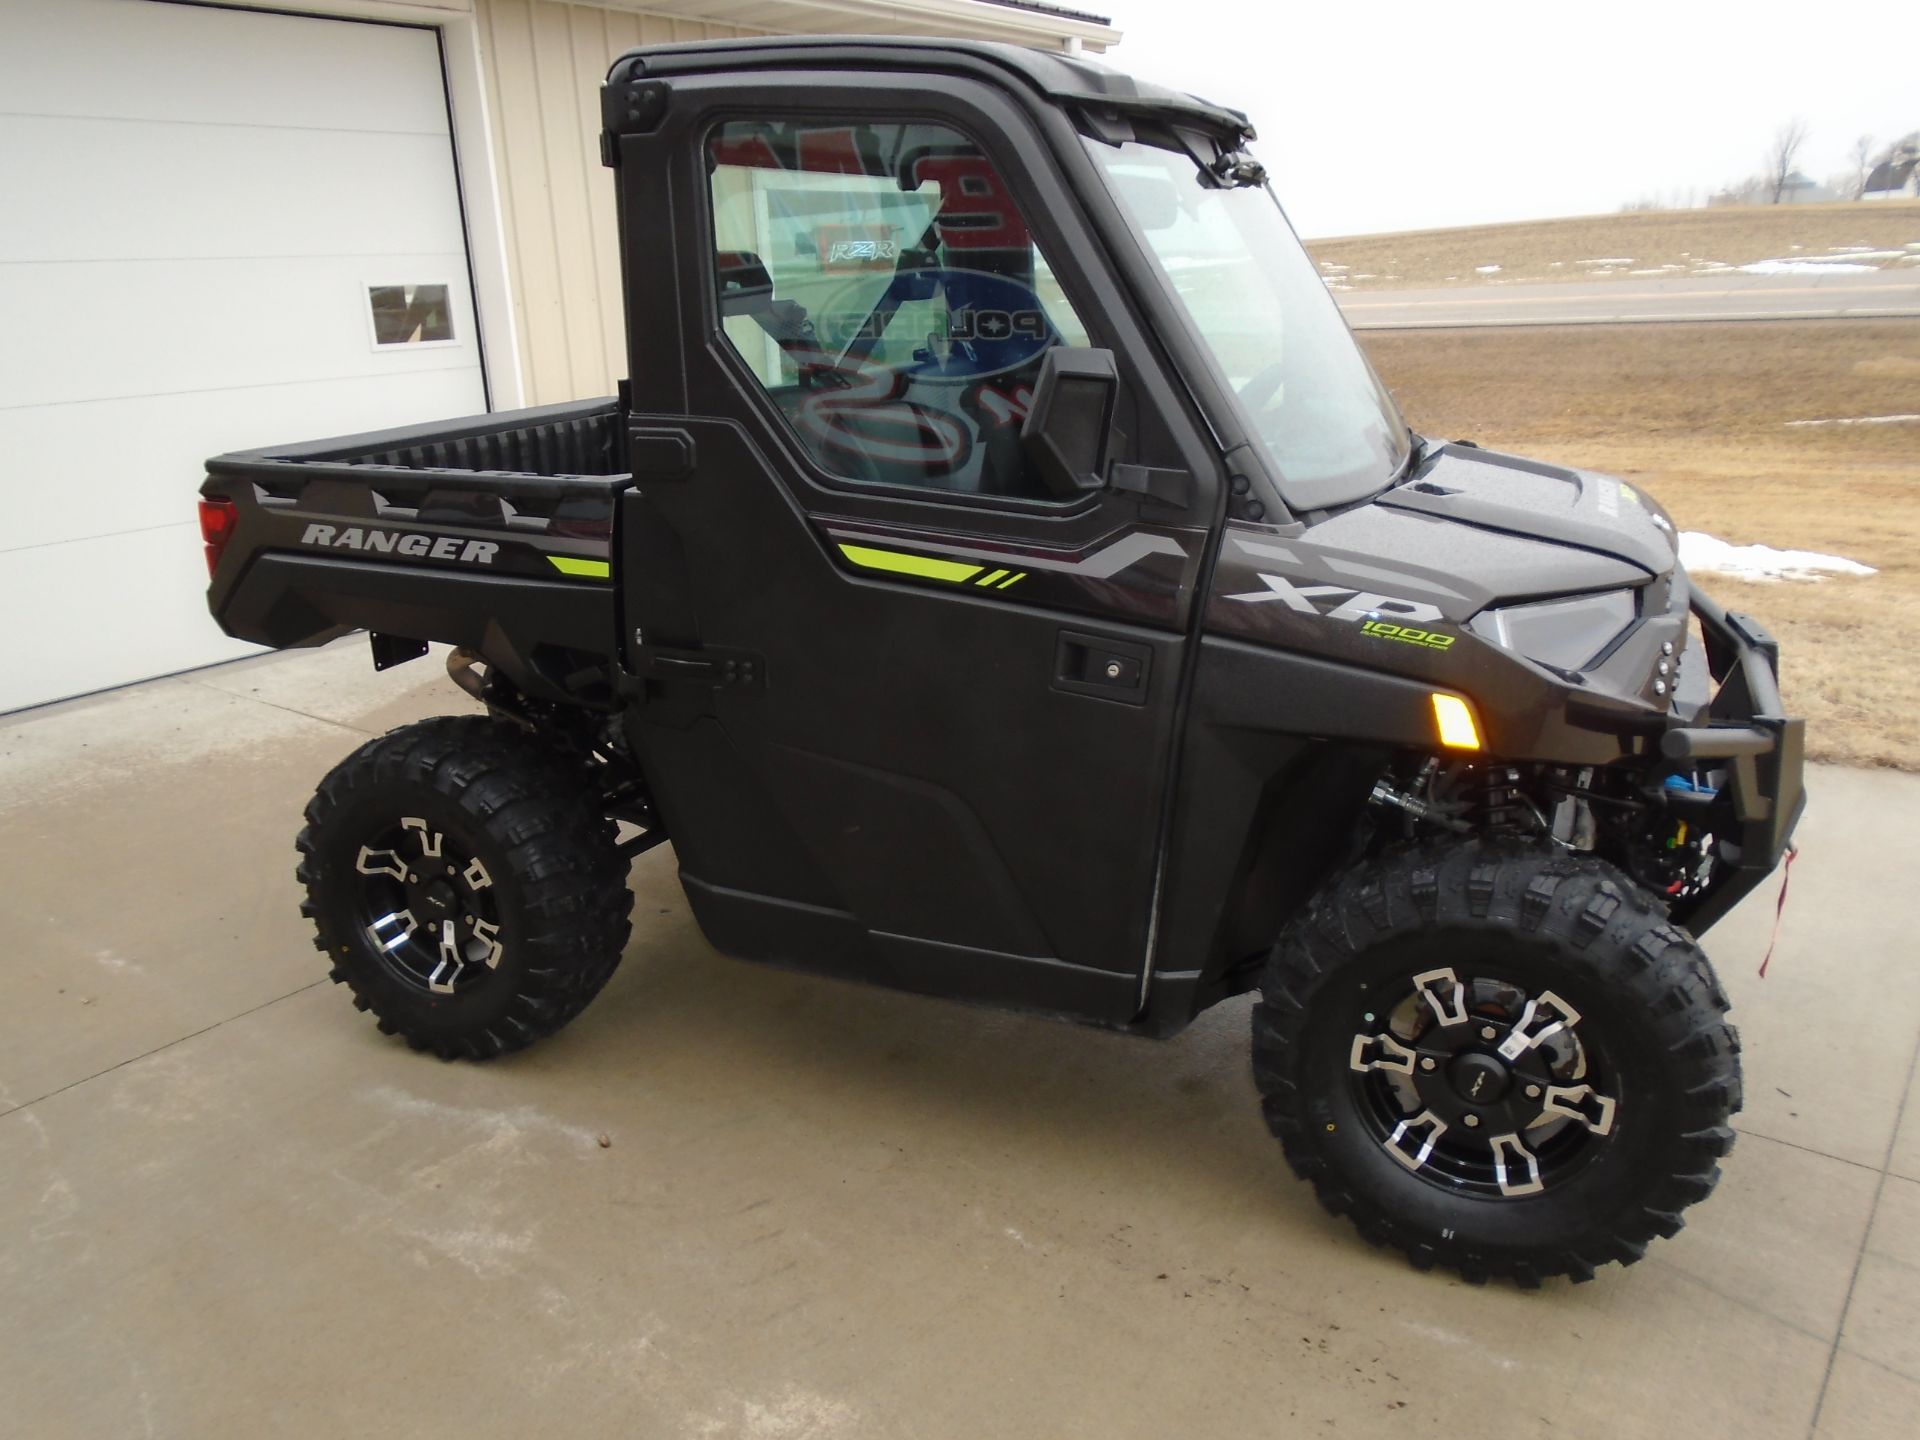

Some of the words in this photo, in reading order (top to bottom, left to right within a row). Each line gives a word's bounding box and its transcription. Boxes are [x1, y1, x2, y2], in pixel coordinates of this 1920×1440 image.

[828, 240, 895, 263] RZR
[301, 524, 499, 563] RANGER
[1222, 573, 1444, 622] XP
[1362, 621, 1455, 645] 1000
